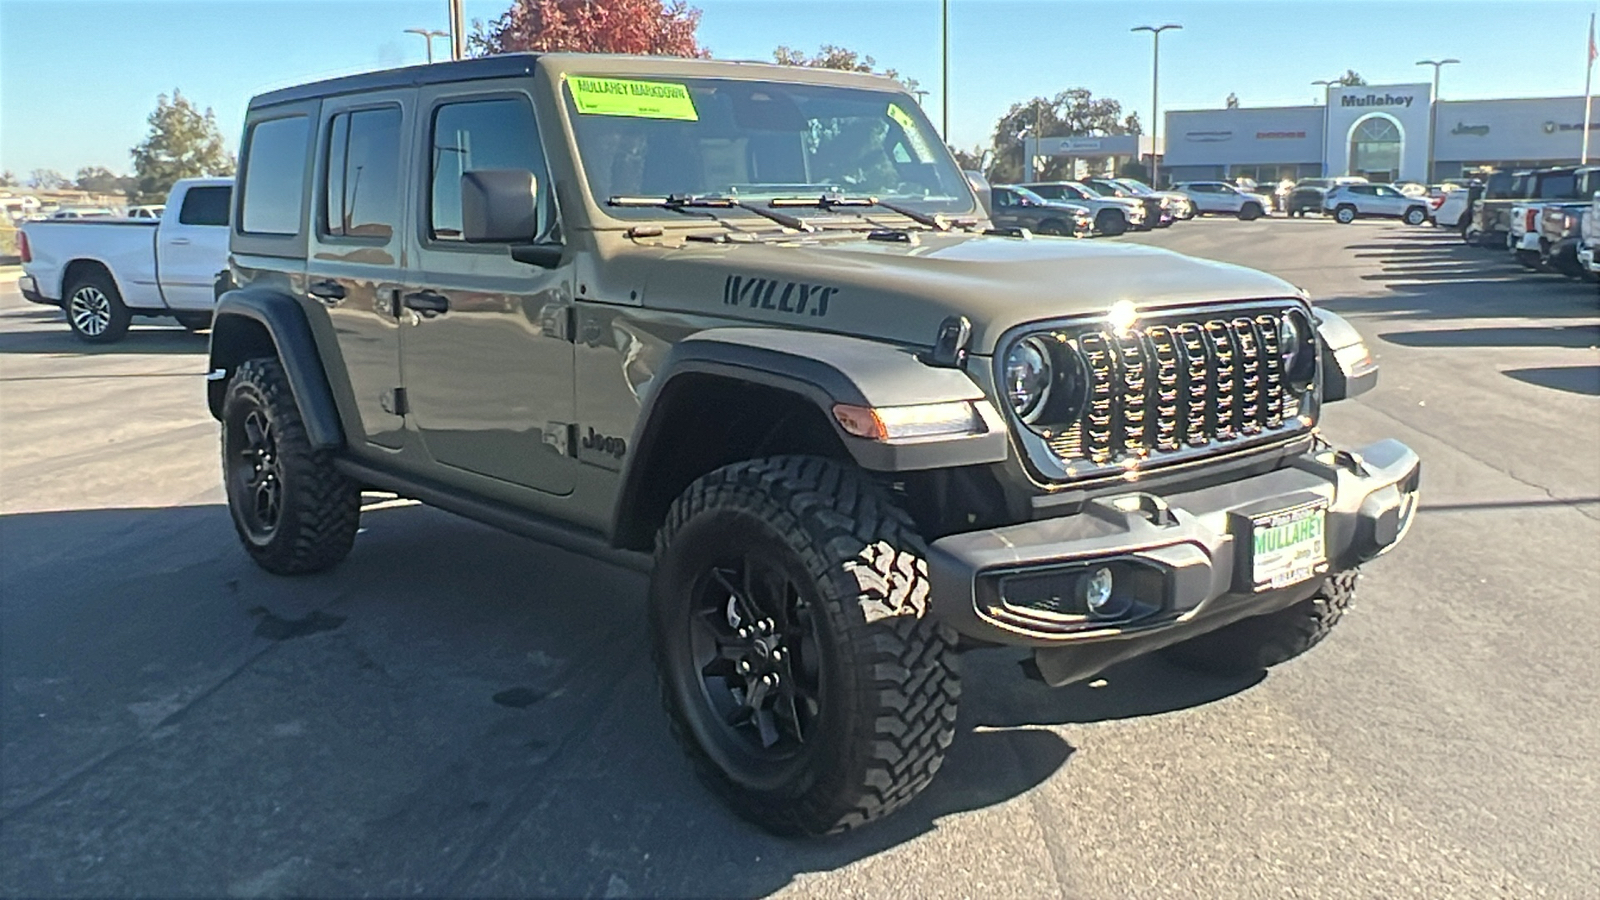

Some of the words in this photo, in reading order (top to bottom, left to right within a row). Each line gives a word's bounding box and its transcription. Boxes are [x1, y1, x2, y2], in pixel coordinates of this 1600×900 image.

[577, 79, 628, 95] MULLAHEY
[630, 83, 685, 99] MARKDOWN
[1341, 94, 1414, 107] Mullahey
[723, 274, 840, 317] WILLYS
[582, 426, 626, 459] Jeep
[1254, 516, 1322, 555] MULLAHEY
